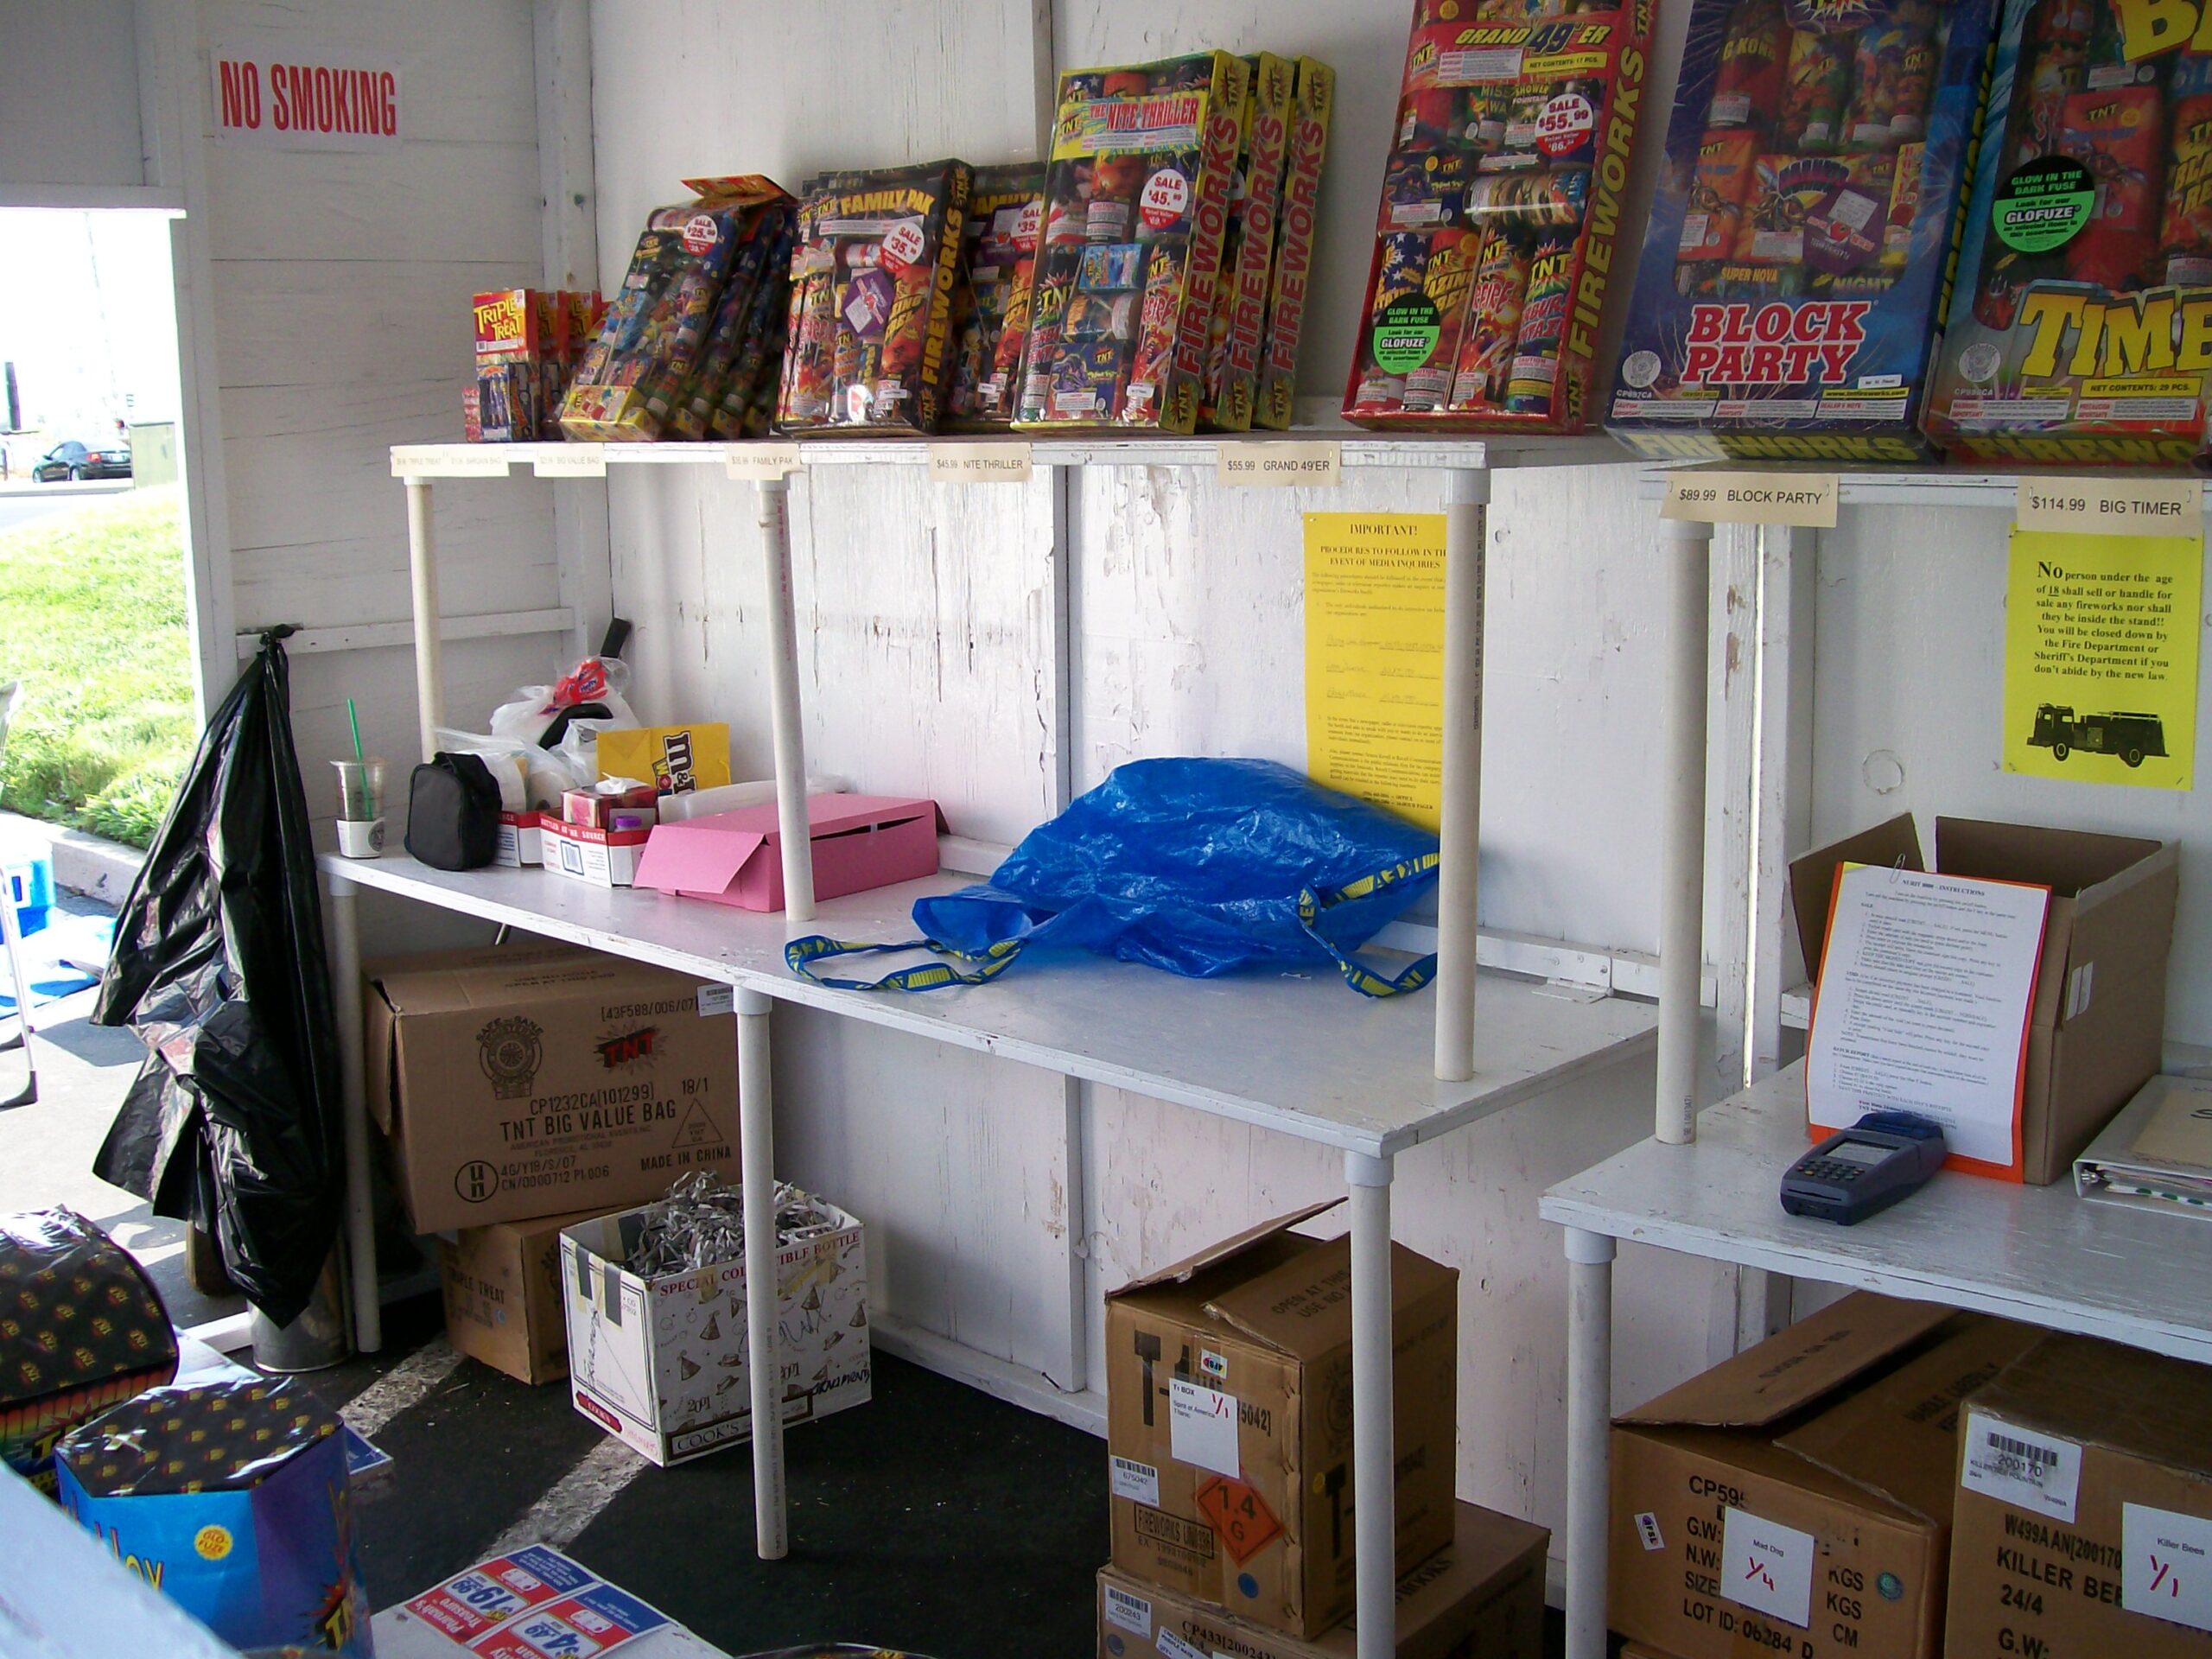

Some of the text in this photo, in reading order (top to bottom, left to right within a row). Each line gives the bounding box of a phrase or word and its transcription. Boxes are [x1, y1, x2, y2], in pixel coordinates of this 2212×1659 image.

[1455, 27, 1531, 44] GRAND
[219, 60, 397, 136] NO SMOKING
[1513, 95, 1548, 105] FOUNTAIN
[1514, 84, 1548, 96] SHOWER
[1090, 97, 1199, 130] THE NITE THRILLER
[1548, 99, 1580, 112] SALE
[1539, 110, 1589, 131] $55.99
[1154, 176, 1183, 190] SALE
[2011, 170, 2082, 186] GLOW IN THE
[2014, 181, 2076, 195] DARK FUSE
[840, 188, 937, 216] FAMILY PAK
[1148, 190, 1182, 207] $45.99
[1568, 46, 1643, 360] FIREWORKS
[2005, 207, 2074, 224] GLOFUZE
[899, 226, 923, 246] SALE
[1177, 115, 1238, 374] FIREWORKS
[1231, 113, 1283, 372] FIREWORKS
[1271, 118, 1324, 371] FIREWORKS
[1529, 252, 1573, 283] TNT
[1721, 267, 1779, 283] SUPER NOVA
[1832, 277, 1894, 291] NIGHT
[921, 207, 964, 386] FIREWORKS
[474, 296, 517, 334] TRIPLE
[1421, 307, 1433, 315] THE
[493, 314, 524, 340] TREAT
[1686, 302, 1871, 344] BLOCK
[1381, 338, 1426, 348] GLOFUZE
[1681, 343, 1860, 385] PARTY
[2107, 384, 2157, 392] CONTENTS:
[2159, 383, 2168, 391] 29
[1627, 434, 1920, 461] FIREWORKS
[752, 455, 794, 465] FAMILY PAK
[963, 460, 981, 469] NITE
[983, 460, 1023, 469] THRILLER
[1227, 460, 1330, 472] $55.99 GRAND 49'ER
[1679, 489, 1822, 505] $89.99 BLOCK PARTY
[2031, 495, 2182, 517] $114.99 BIG TIMER
[1350, 524, 1418, 536] IMPORTANT!
[1320, 545, 1370, 555] PROCEDURES
[1385, 548, 1421, 556] FOLLOW
[1434, 549, 1446, 557] TH
[1330, 557, 1354, 566] EVENT
[1368, 558, 1395, 567] MEDIA
[1397, 560, 1440, 569] INQUIRIES
[2037, 561, 2173, 586] No person under the age
[2036, 585, 2173, 600] of 18 shall sell or handle for
[2036, 599, 2055, 607] sale
[2056, 601, 2073, 610] any
[2076, 601, 2123, 612] fireworks
[2147, 603, 2171, 613] shall
[2042, 613, 2164, 626] they be inside the stand!!
[2037, 625, 2168, 642] You will be closed down by
[2044, 639, 2159, 653] the Fire Department or
[2034, 651, 2169, 669] Sheriff's Department if you
[2034, 664, 2167, 681] don't abide by the new law.
[579, 678, 598, 694] Hefty
[1939, 884, 1986, 896] INSTRUCTIONS
[602, 1027, 657, 1068] TNT
[682, 1077, 709, 1096] 18/1
[530, 1082, 655, 1116] CP1232CA[101299]
[499, 1100, 677, 1142] TNT BIG VALUE BAG
[640, 1146, 732, 1171] MADE IN CHINA
[659, 1231, 861, 1297] SPECIAL BOTTLE
[479, 1281, 505, 1305] TREAT
[1272, 1284, 1323, 1315] OPEN AT
[1298, 1291, 1344, 1319] USE NO
[1181, 1387, 1195, 1397] BOX
[1193, 1406, 1216, 1418] America
[677, 1420, 741, 1452] COOK'S
[1997, 1454, 2044, 1478] 200170
[1218, 1484, 1255, 1520] 1.4
[1230, 1521, 1244, 1541] G
[1687, 1516, 1722, 1544] G.W:
[2004, 1513, 2050, 1548] W499A
[198, 1541, 225, 1554] FUZE
[1752, 1539, 1785, 1558] Mad Dog
[2157, 1538, 2205, 1556] Killer Bees
[1686, 1544, 1721, 1572] N.W:
[1745, 1556, 1775, 1592] 1/4
[1997, 1545, 2074, 1592] KILLER
[1826, 1592, 1863, 1620] KGS
[2000, 1583, 2044, 1617] 24/4
[1116, 1604, 1141, 1620] 200243
[1683, 1599, 1715, 1624] LOT
[1718, 1611, 1738, 1634] ID:
[1833, 1623, 1859, 1649] CM
